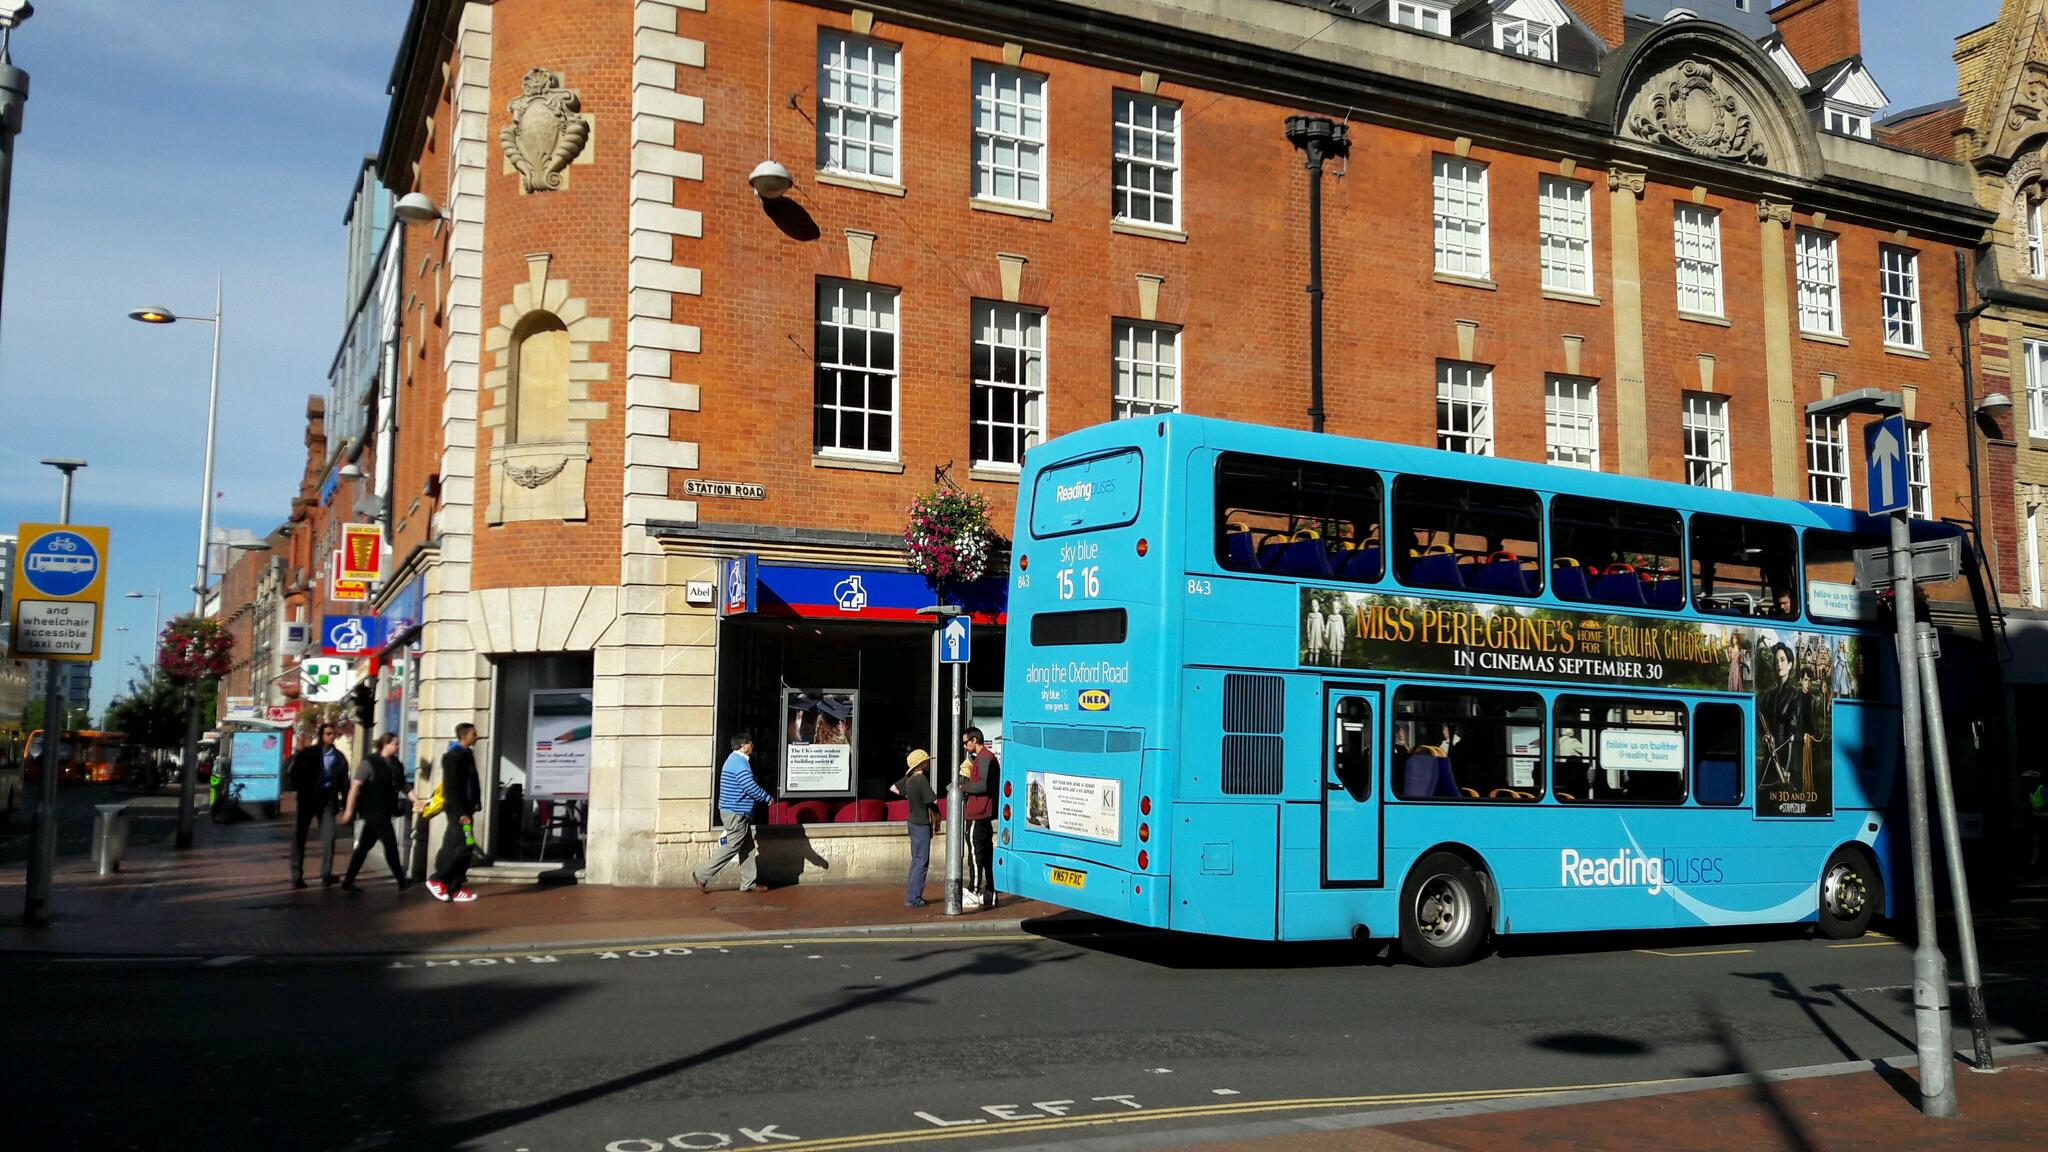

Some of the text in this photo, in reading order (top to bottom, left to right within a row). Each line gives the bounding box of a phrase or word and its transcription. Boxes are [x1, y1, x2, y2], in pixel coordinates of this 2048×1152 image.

[687, 482, 764, 497] STATION ROAD
[1060, 540, 1099, 566] sky blue
[1017, 575, 1030, 589] 843
[1056, 565, 1100, 600] 15 16
[1187, 579, 1212, 595] 843
[689, 587, 710, 597] Abel
[46, 607, 69, 615] and
[23, 616, 90, 627] wheelchair
[23, 628, 87, 638] accessible
[1355, 604, 1575, 655] MISS PEREGRINE'S
[1577, 629, 1603, 642] HOME
[28, 639, 80, 650] taxi only
[1581, 642, 1600, 654] FOR
[1607, 624, 1720, 665] PECULIAR CHILDREN
[1453, 649, 1663, 680] IN CINEMAS SEPTEMBER 30
[1025, 661, 1129, 688] along the Oxford Road
[1082, 695, 1107, 704] IKEA
[1606, 739, 1628, 751] follow
[1630, 742, 1638, 750] us
[1639, 742, 1649, 750] on
[1769, 790, 1818, 802] IN 3D AND 2D
[1053, 868, 1083, 886] YN57 FXC
[912, 1094, 1143, 1129] LEFT
